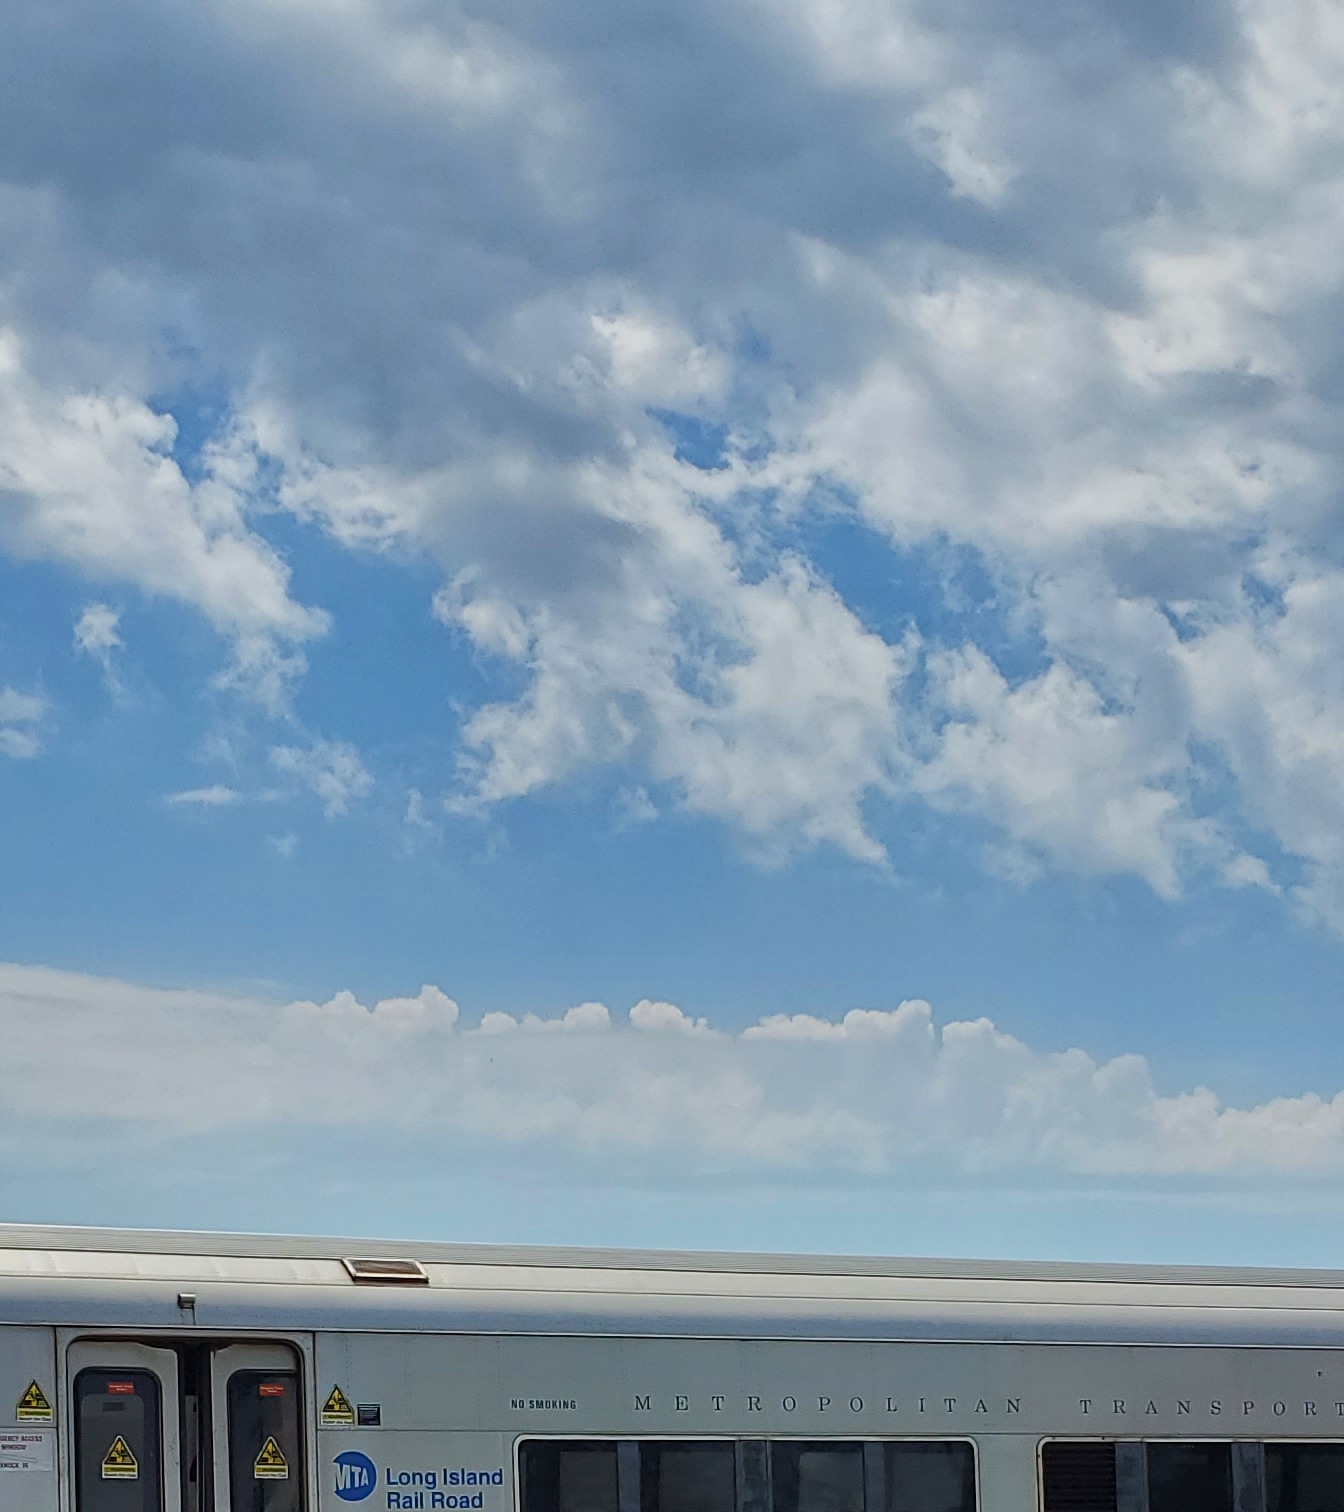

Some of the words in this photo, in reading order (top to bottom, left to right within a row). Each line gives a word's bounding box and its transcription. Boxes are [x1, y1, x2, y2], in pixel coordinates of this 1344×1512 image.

[511, 1399, 525, 1409] NO
[528, 1399, 577, 1410] SMOKING
[634, 1395, 1021, 1414] METROPOLITAN
[335, 1463, 369, 1491] MTA
[386, 1468, 436, 1489] Long
[443, 1468, 504, 1485] Island
[387, 1491, 424, 1509] Rail
[431, 1491, 483, 1509] Road
